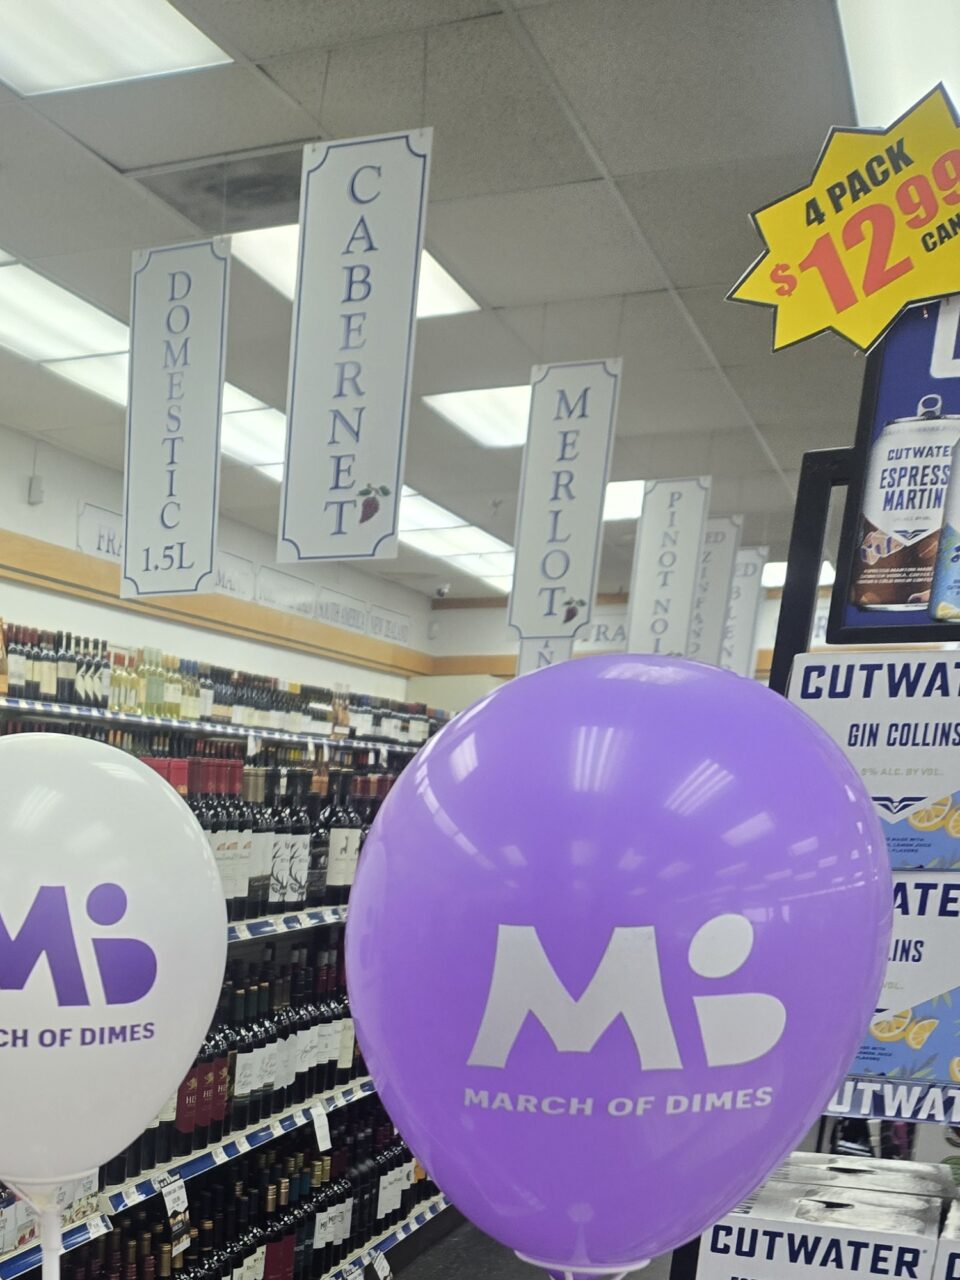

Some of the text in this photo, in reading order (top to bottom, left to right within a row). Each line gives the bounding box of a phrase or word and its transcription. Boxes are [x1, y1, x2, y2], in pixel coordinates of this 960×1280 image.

[804, 137, 915, 228] 4 PACK
[323, 164, 383, 536] CABERNET
[160, 271, 192, 530] DOMESTIC
[537, 386, 591, 617] MERLOT
[141, 541, 195, 573] 1.5L
[657, 491, 682, 588] PINOT
[847, 722, 880, 747] GIN
[38, 1028, 73, 1047] OF
[80, 1022, 156, 1046] DIMES
[464, 1087, 774, 1116] MARCH OF DIMES
[710, 1224, 921, 1279] CUTWATER
